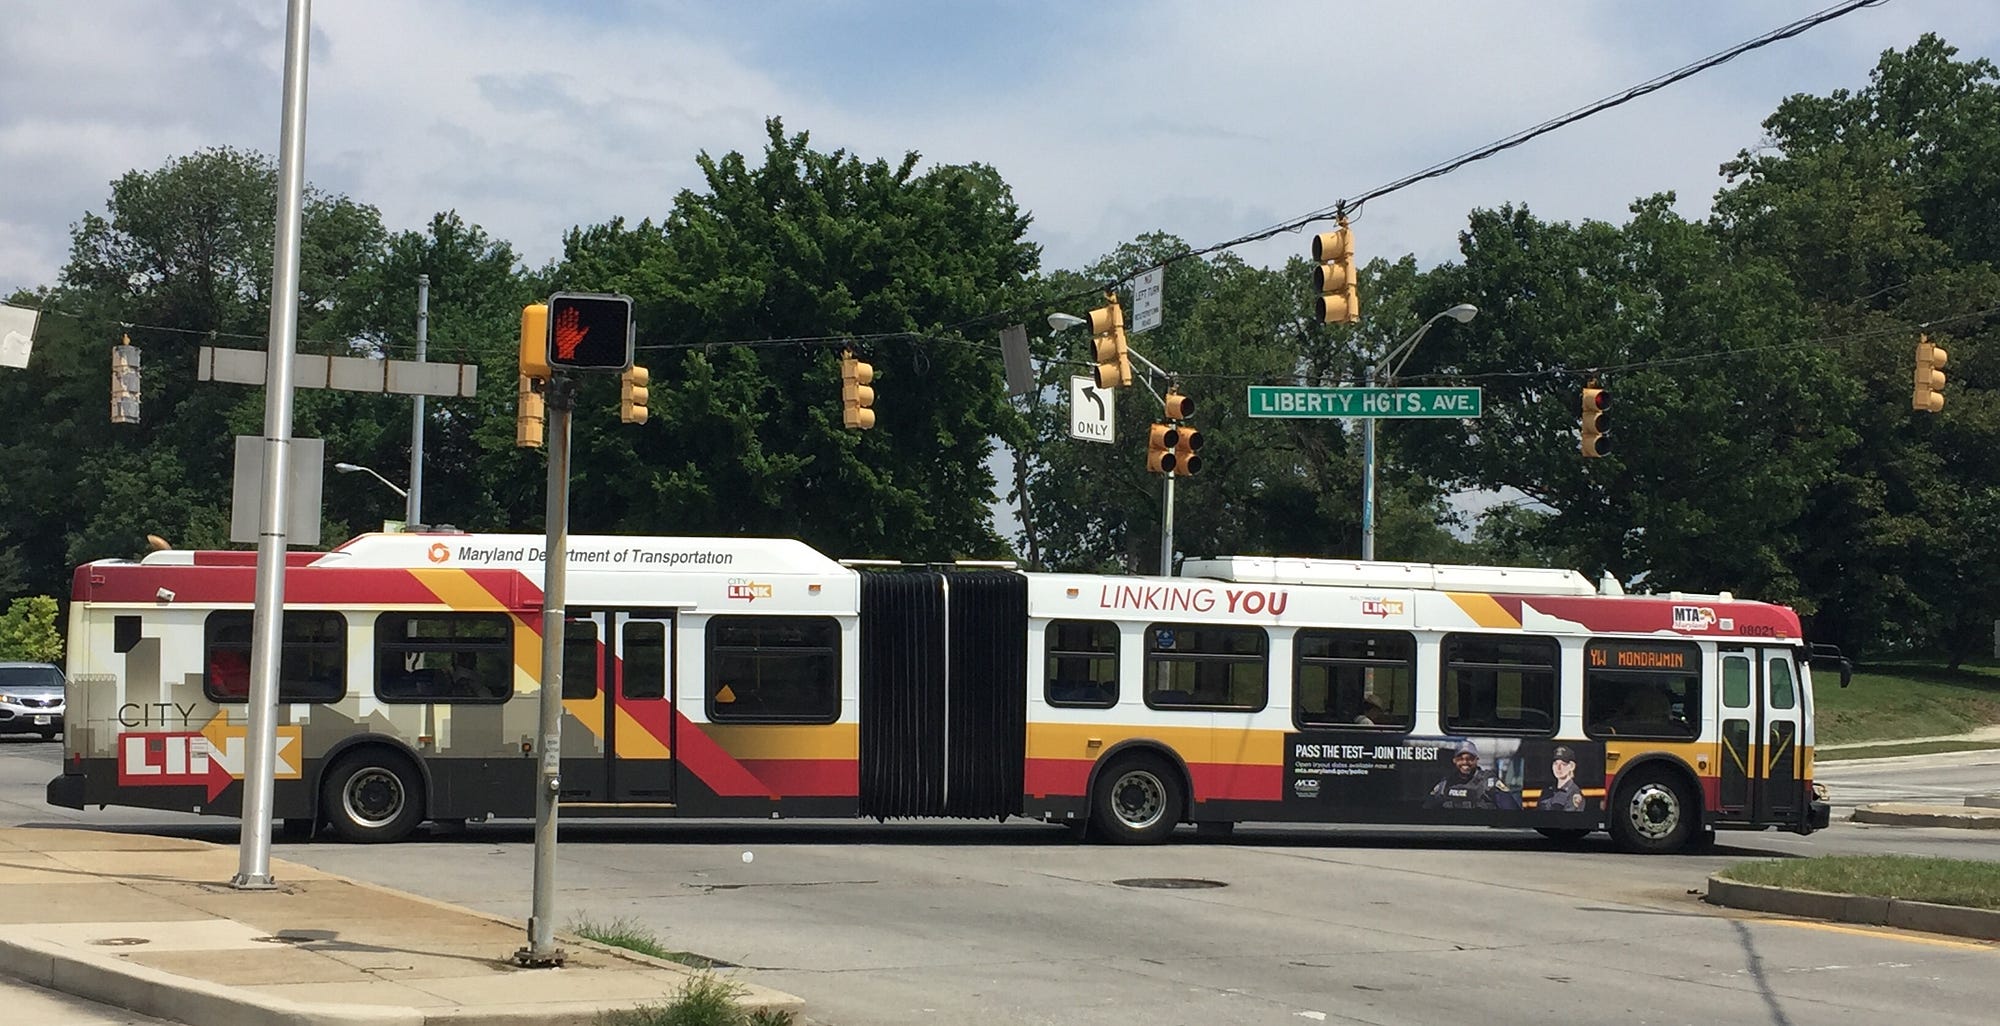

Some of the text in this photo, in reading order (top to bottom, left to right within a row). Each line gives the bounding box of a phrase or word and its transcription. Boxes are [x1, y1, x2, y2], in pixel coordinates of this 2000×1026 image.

[1260, 392, 1474, 412] LIBERTY HGTS. AVE.
[1078, 421, 1108, 436] ONLY
[458, 546, 733, 567] Maryland Dertment of Transportation
[728, 577, 748, 585] CITY
[729, 586, 770, 598] LINK
[1100, 584, 1289, 616] LINKING YOU
[1364, 602, 1402, 614] LINK
[1675, 607, 1700, 622] MTA
[1740, 624, 1775, 637] 08021
[1590, 649, 1684, 668] YW MONDAWMIN
[118, 703, 196, 728] CITY
[1295, 744, 1320, 758] PASS
[1322, 744, 1340, 758] THE
[1396, 746, 1413, 760] THE
[1414, 746, 1439, 760] BEST
[1295, 761, 1312, 769] Open
[1448, 789, 1468, 797] POLICE
